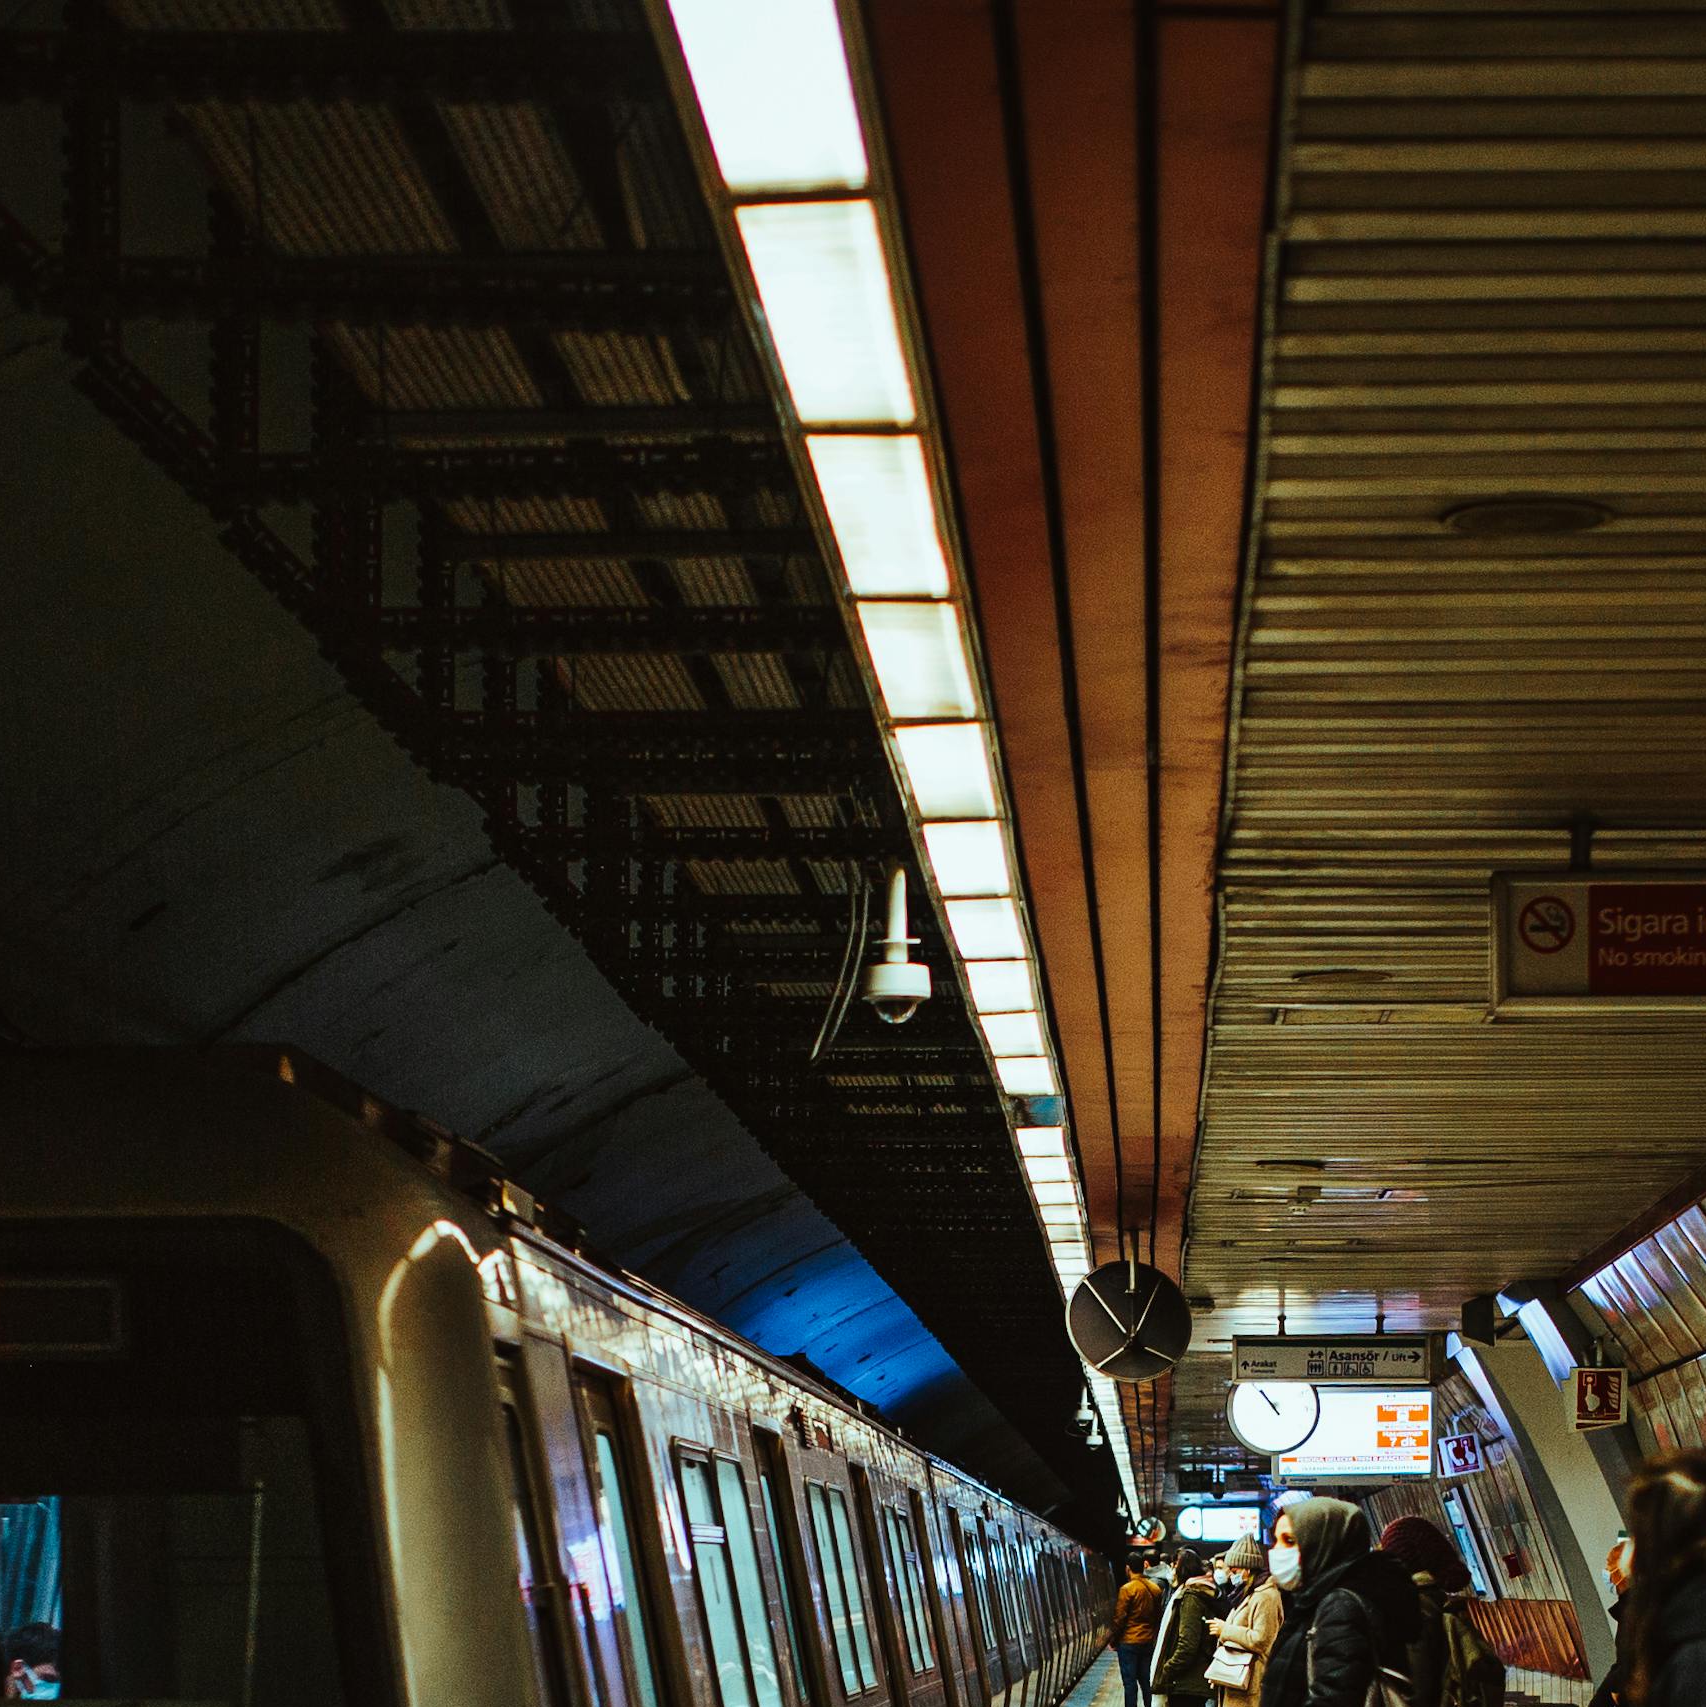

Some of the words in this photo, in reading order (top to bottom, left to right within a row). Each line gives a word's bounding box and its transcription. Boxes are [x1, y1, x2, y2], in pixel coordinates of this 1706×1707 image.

[1597, 907, 1690, 942] Sigara
[1597, 947, 1629, 967] No
[1329, 1350, 1378, 1362] Asansör
